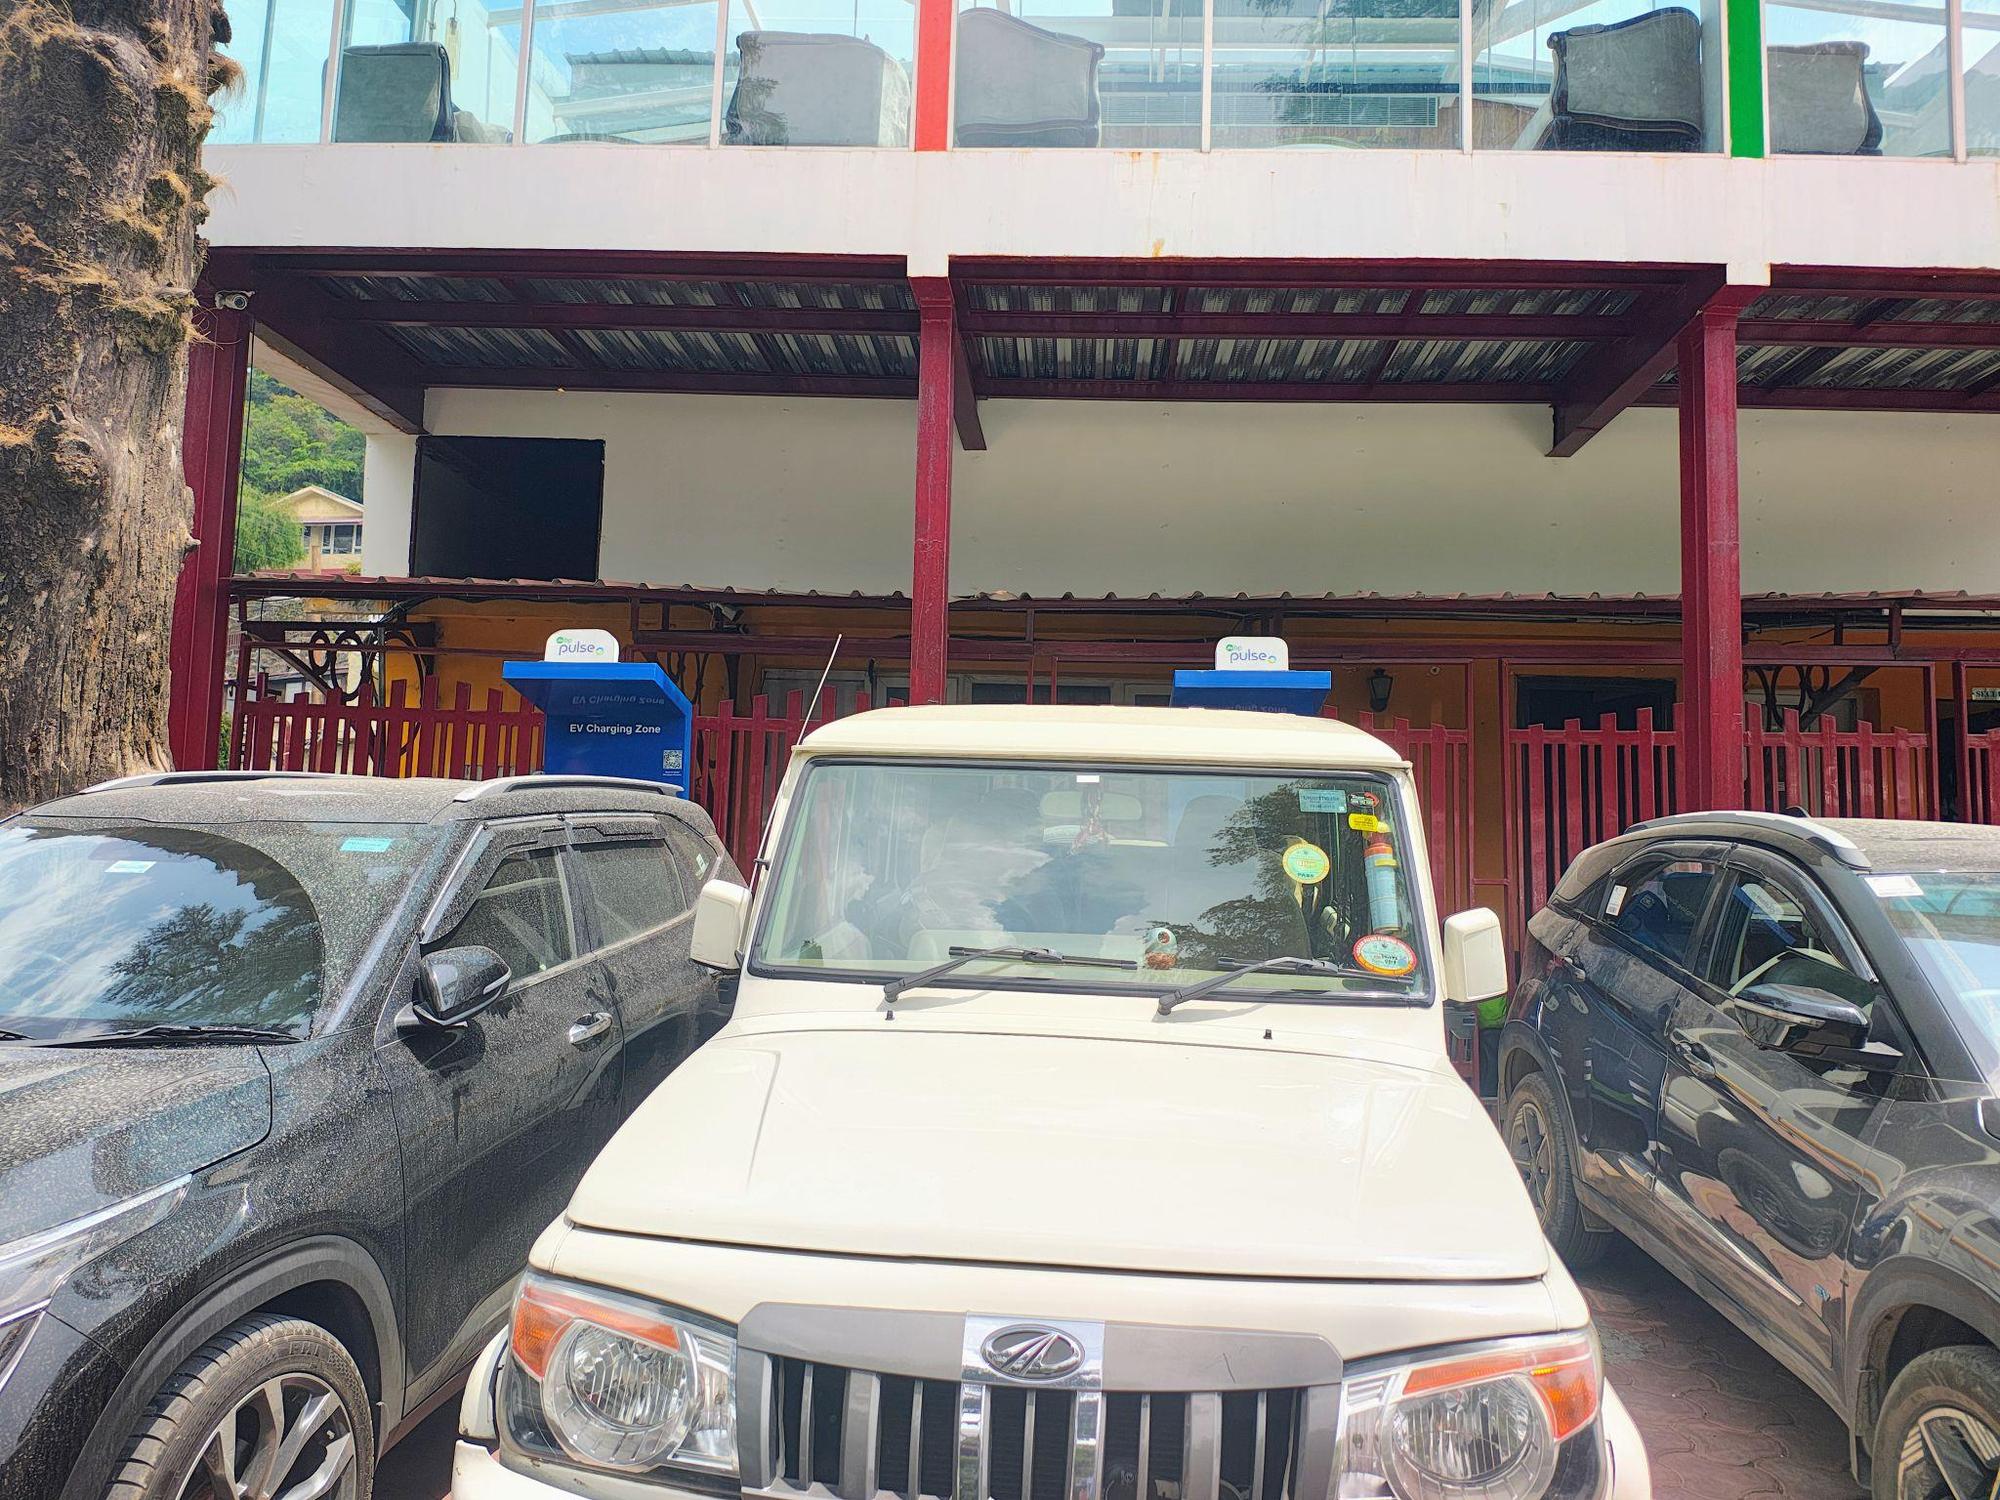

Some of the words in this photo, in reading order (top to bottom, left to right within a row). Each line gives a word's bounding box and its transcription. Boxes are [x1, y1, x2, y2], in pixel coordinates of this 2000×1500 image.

[559, 641, 595, 656] pulse
[1230, 649, 1267, 663] pulse
[569, 724, 584, 733] EV
[586, 723, 633, 735] Charging
[635, 724, 661, 734] Zone
